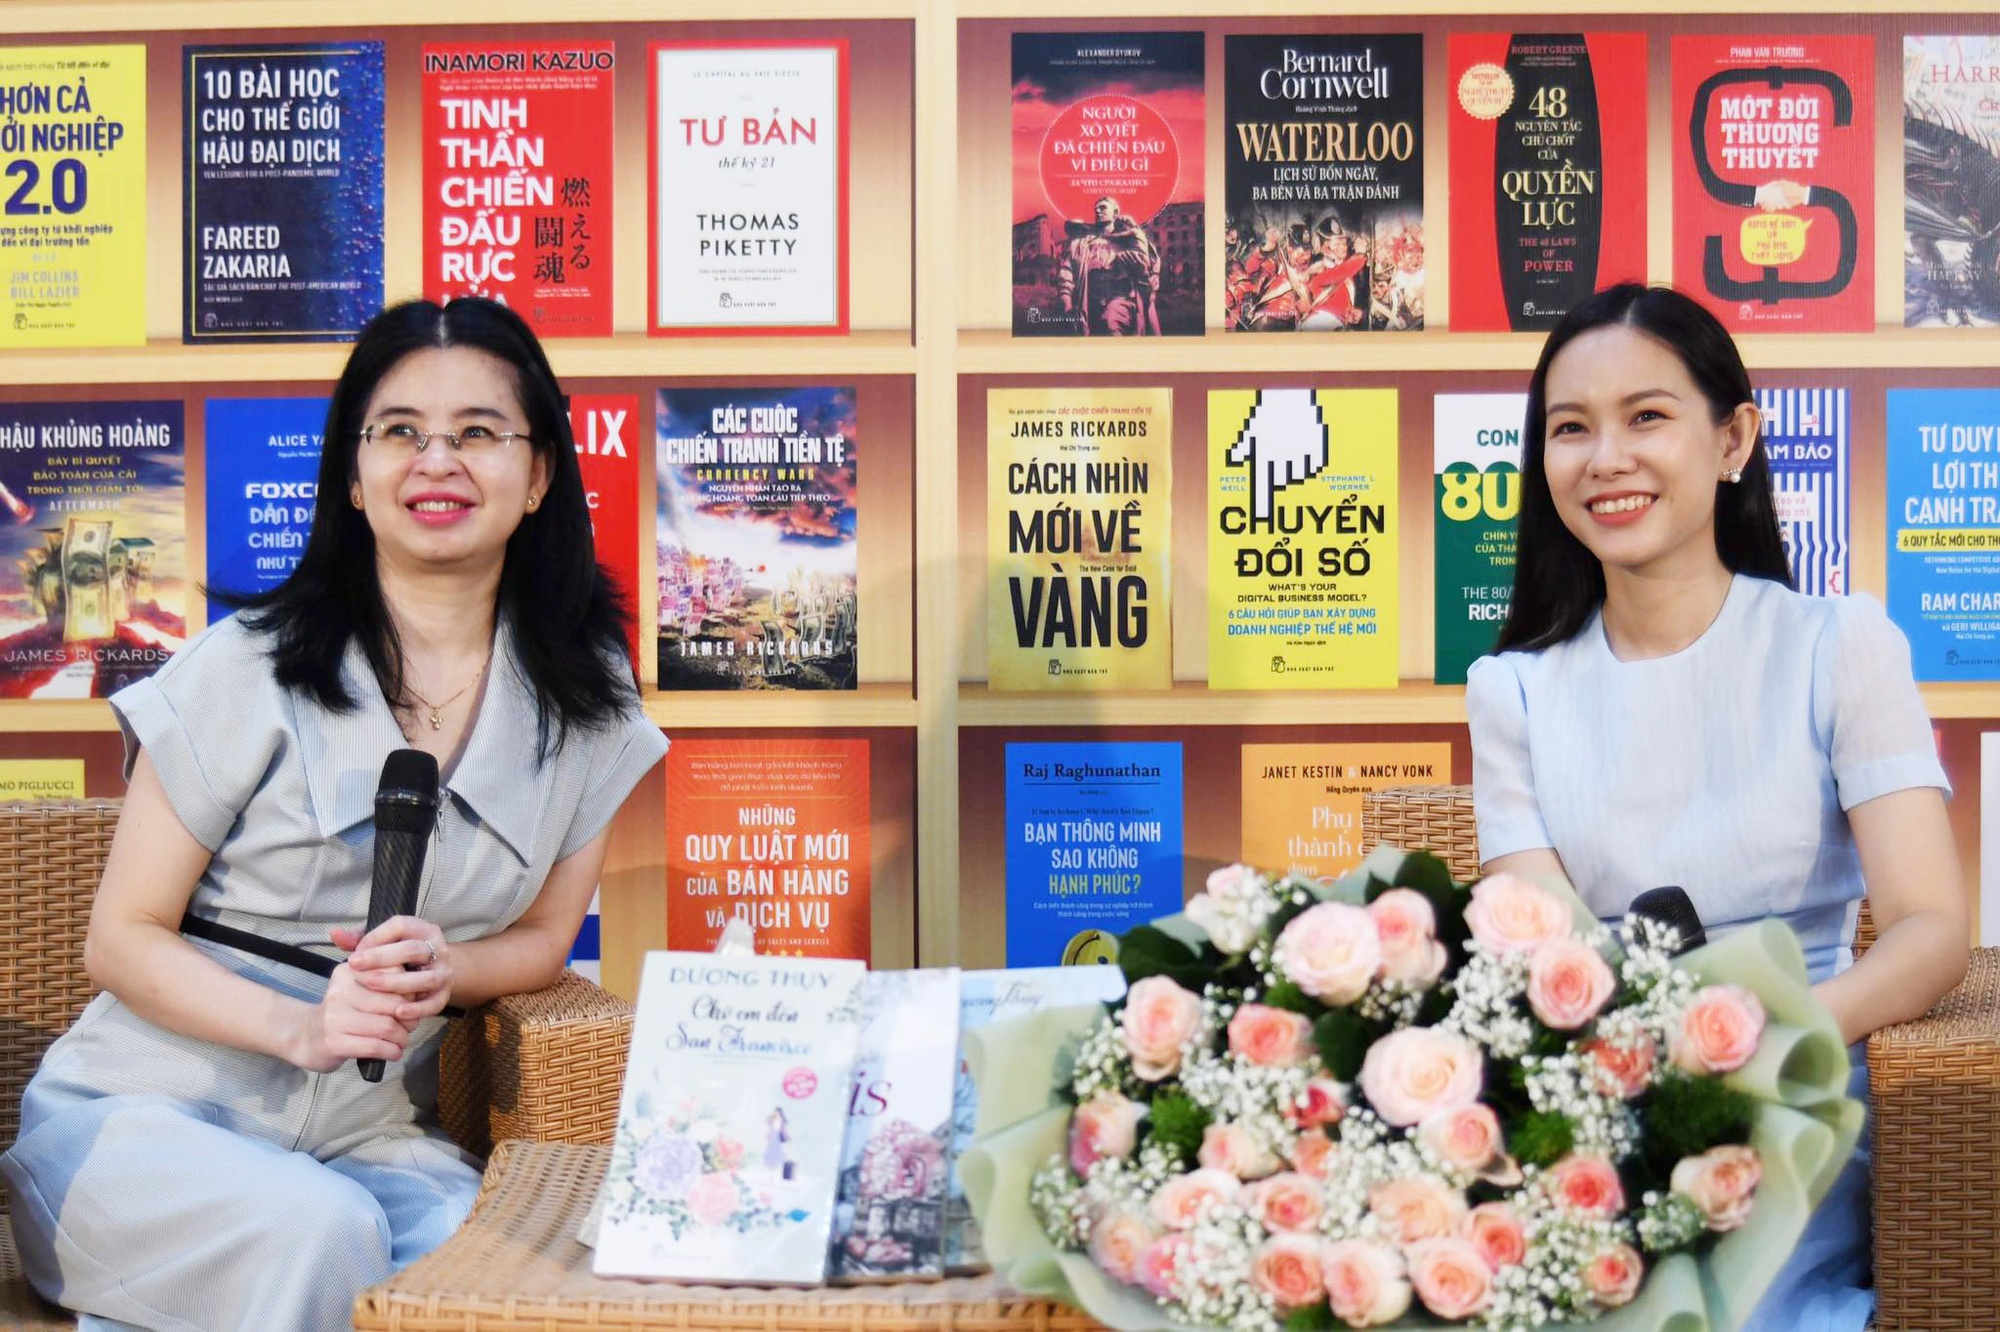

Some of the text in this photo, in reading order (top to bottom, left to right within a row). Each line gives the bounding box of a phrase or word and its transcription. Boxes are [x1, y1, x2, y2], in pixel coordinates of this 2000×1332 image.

[425, 51, 614, 72] INAMORI KAZUO
[1283, 48, 1371, 74] Bernard
[1511, 45, 1586, 54] ROBERT GREENE
[204, 62, 340, 104] 10 BÀI HỌC
[1260, 67, 1390, 100] Cornwell
[202, 99, 340, 132] CHO THẾ GIỚI
[439, 98, 528, 129] TINH
[1528, 86, 1568, 118] 48
[1720, 94, 1819, 122] MỘT ĐỜI
[32, 115, 124, 157] NGHIỆP
[679, 107, 817, 146] TƯ BẢN
[1105, 121, 1139, 136] VIẾT
[1515, 119, 1558, 132] NGUYÊN
[1545, 132, 1575, 146] CHỐT
[203, 135, 340, 169] HẬU ĐẠI DỊCH
[439, 128, 544, 168] THẦN
[1235, 121, 1414, 162] WATERLOO
[718, 156, 740, 169] thế
[761, 156, 775, 169] 21
[1721, 144, 1819, 169] THUYẾT
[5, 158, 87, 215] 2.0
[441, 168, 554, 207] CHIẾN
[1502, 158, 1595, 201] QUYỀN
[561, 177, 591, 270] 燃える
[696, 213, 800, 231] THOMAS
[1521, 197, 1576, 230] LỰC
[203, 226, 280, 250] FAREED
[440, 208, 521, 247] ĐẤU
[700, 239, 797, 256] PIKETTY
[1542, 250, 1555, 258] OF
[33, 271, 79, 283] COLLINS
[203, 254, 291, 279] ZAKARIA
[441, 248, 516, 284] RỰC
[1523, 260, 1574, 273] POWER
[712, 403, 798, 438] CÁC CUỘC
[1010, 420, 1147, 438] JAMES RICKARDS
[0, 417, 171, 453] HẬU KHỦNG HOẢNG
[1477, 429, 1519, 447] CON
[1918, 423, 1994, 453] TƯ DUY
[666, 430, 845, 468] CHIẾN TRANH TIỀN TỆ
[60, 468, 90, 480] TOÀN
[93, 467, 114, 479] CỦA
[1008, 456, 1148, 494] CÁCH NHÌN
[1932, 459, 1965, 494] LỢI
[26, 485, 64, 495] TRONG
[68, 482, 93, 494] THỜI
[95, 484, 122, 494] GIAN
[245, 482, 319, 499] FOXC
[48, 500, 123, 512] AFTERMATH
[1220, 494, 1385, 535] CHUYỂN
[1904, 496, 1965, 525] CẠNH
[248, 526, 303, 549] CHIẾN
[1009, 500, 1142, 553] MỚI VỀ
[1234, 537, 1371, 577] ĐỔI SỐ
[1475, 541, 1496, 553] CỦA
[1237, 593, 1367, 603] DIGITAL BUSINESS MODEL?
[1268, 583, 1337, 591] WHAT'S YOUR
[1009, 562, 1147, 648] VÀNG
[1228, 607, 1376, 620] 6 CÂU HỎI GIÚP BẠN XÂY DỰNG
[4, 648, 170, 662] JAMES RICKARDS
[680, 640, 834, 657] JAMES RICKARDS
[1023, 763, 1161, 781] Raj Raghunathan
[1262, 766, 1297, 779] JANET
[1302, 765, 1343, 778] KESTIN
[1360, 765, 1398, 778] NANCY
[1402, 765, 1433, 778] VONK
[18, 781, 74, 791] PIGLIUCCI
[738, 803, 796, 826] NHỮNG
[1312, 806, 1352, 834] Phụ
[1024, 818, 1161, 845] BẠN THÔNG MINH
[685, 828, 850, 865] QUY LUẬT MỚI
[1051, 844, 1138, 869] SAO KHÔNG
[686, 864, 849, 896] CỦA BÁN HÀNG
[1049, 869, 1142, 899] HẠNH PHÚC?
[705, 901, 830, 933] VÀ DỊCH VỤ
